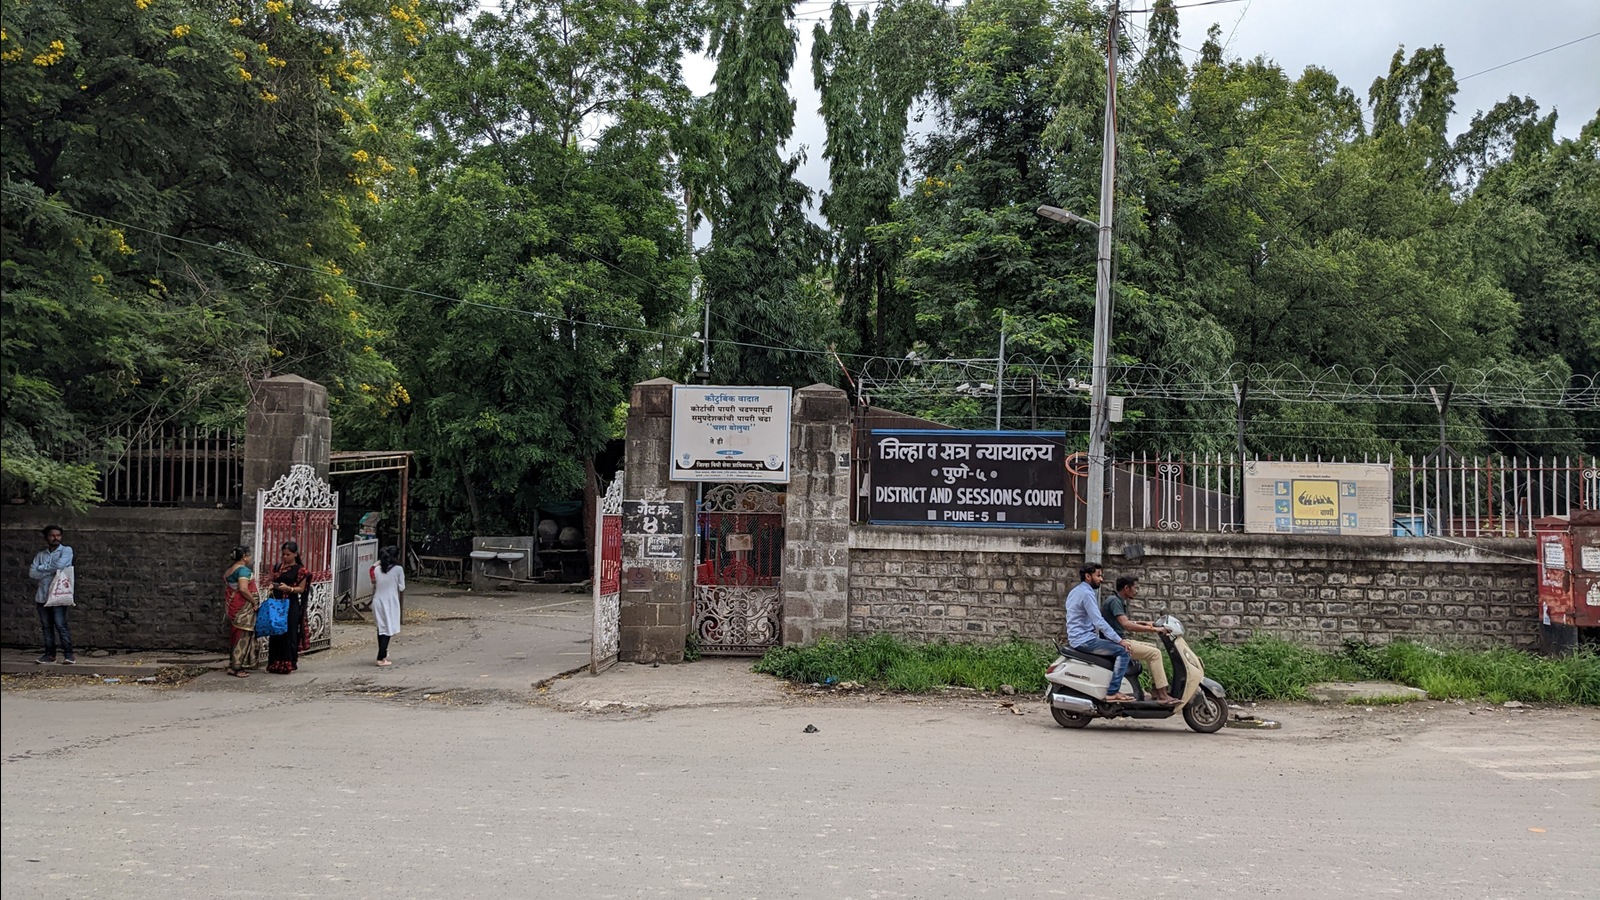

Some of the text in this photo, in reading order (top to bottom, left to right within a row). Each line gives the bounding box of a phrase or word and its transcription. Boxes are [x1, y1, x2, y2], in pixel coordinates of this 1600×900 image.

[718, 405, 735, 413] पायरी
[878, 437, 1055, 463] जिल्हा व सत्र न्यायालय
[942, 463, 987, 484] पुणे-५
[876, 486, 1063, 506] DISTRICT AND SESSIONS COURT
[944, 510, 989, 521] PUNE-5
